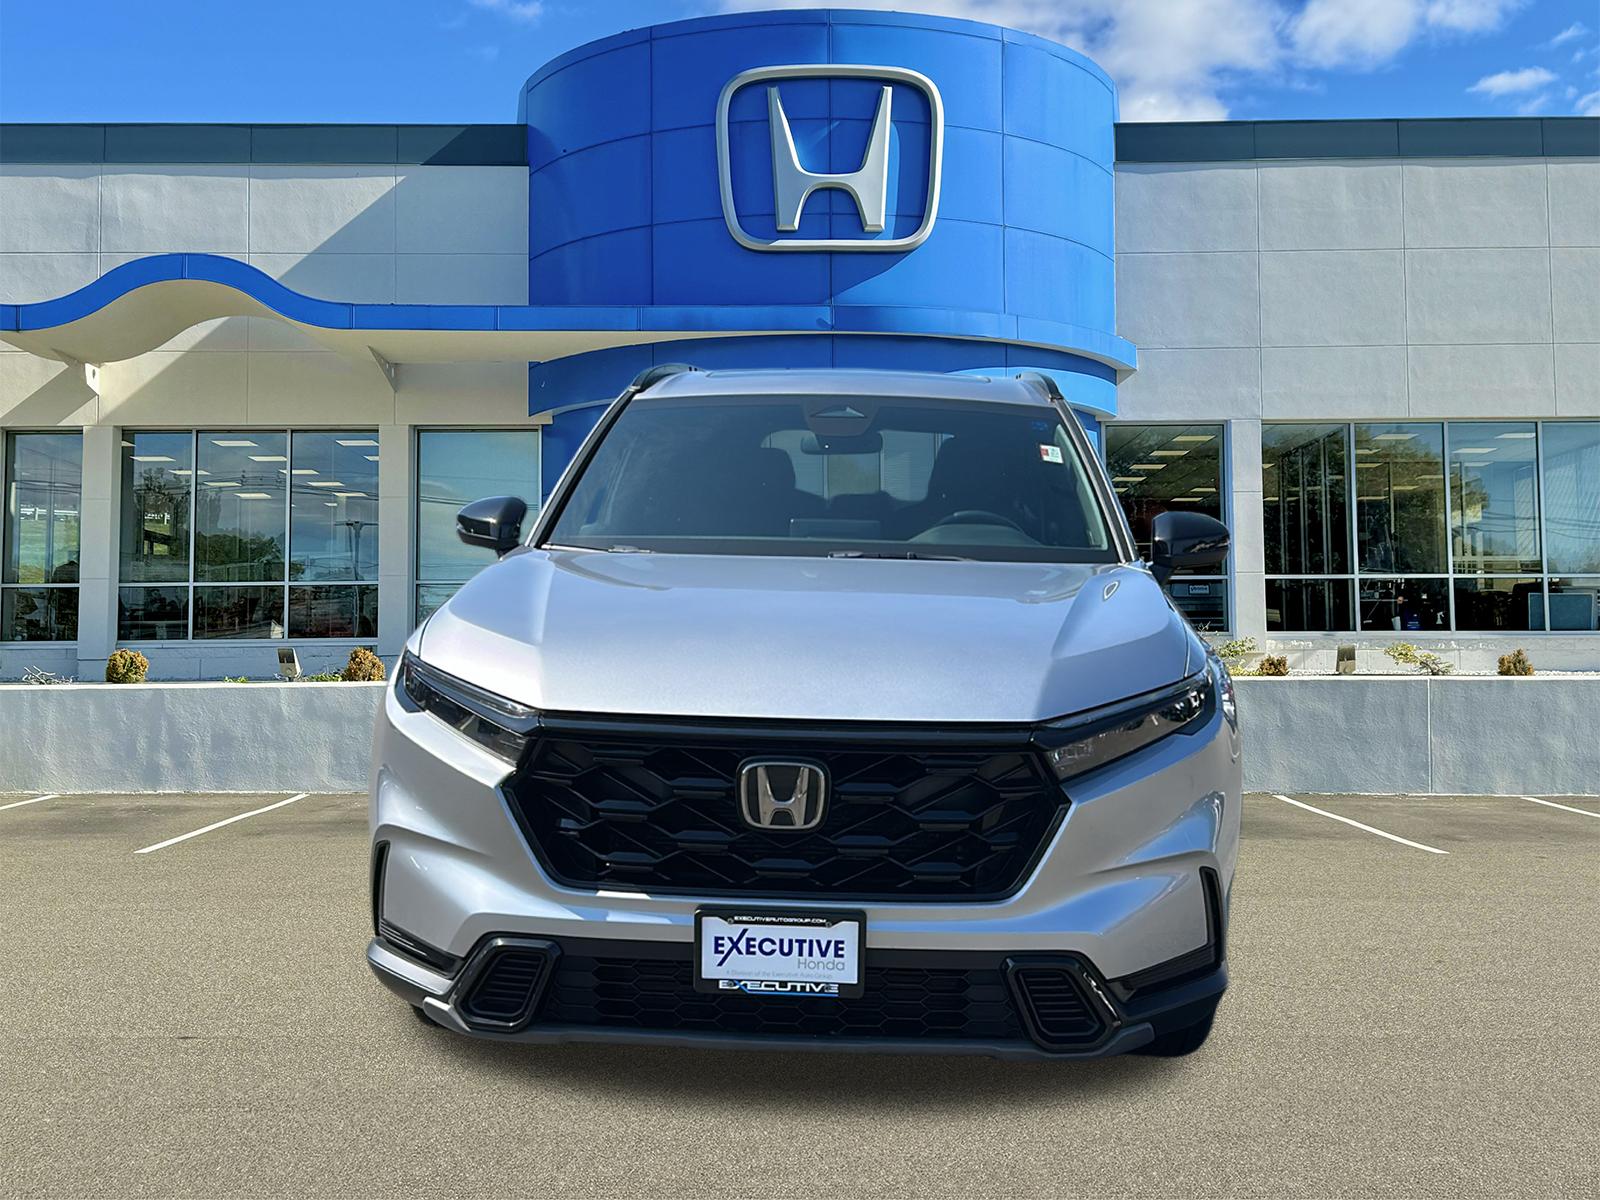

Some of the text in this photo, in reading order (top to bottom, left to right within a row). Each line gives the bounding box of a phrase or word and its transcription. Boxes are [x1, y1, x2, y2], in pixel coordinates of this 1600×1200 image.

[714, 928, 845, 967] EXECUTIVE
[797, 957, 845, 971] Honda
[718, 979, 839, 993] EXECUTIVE
